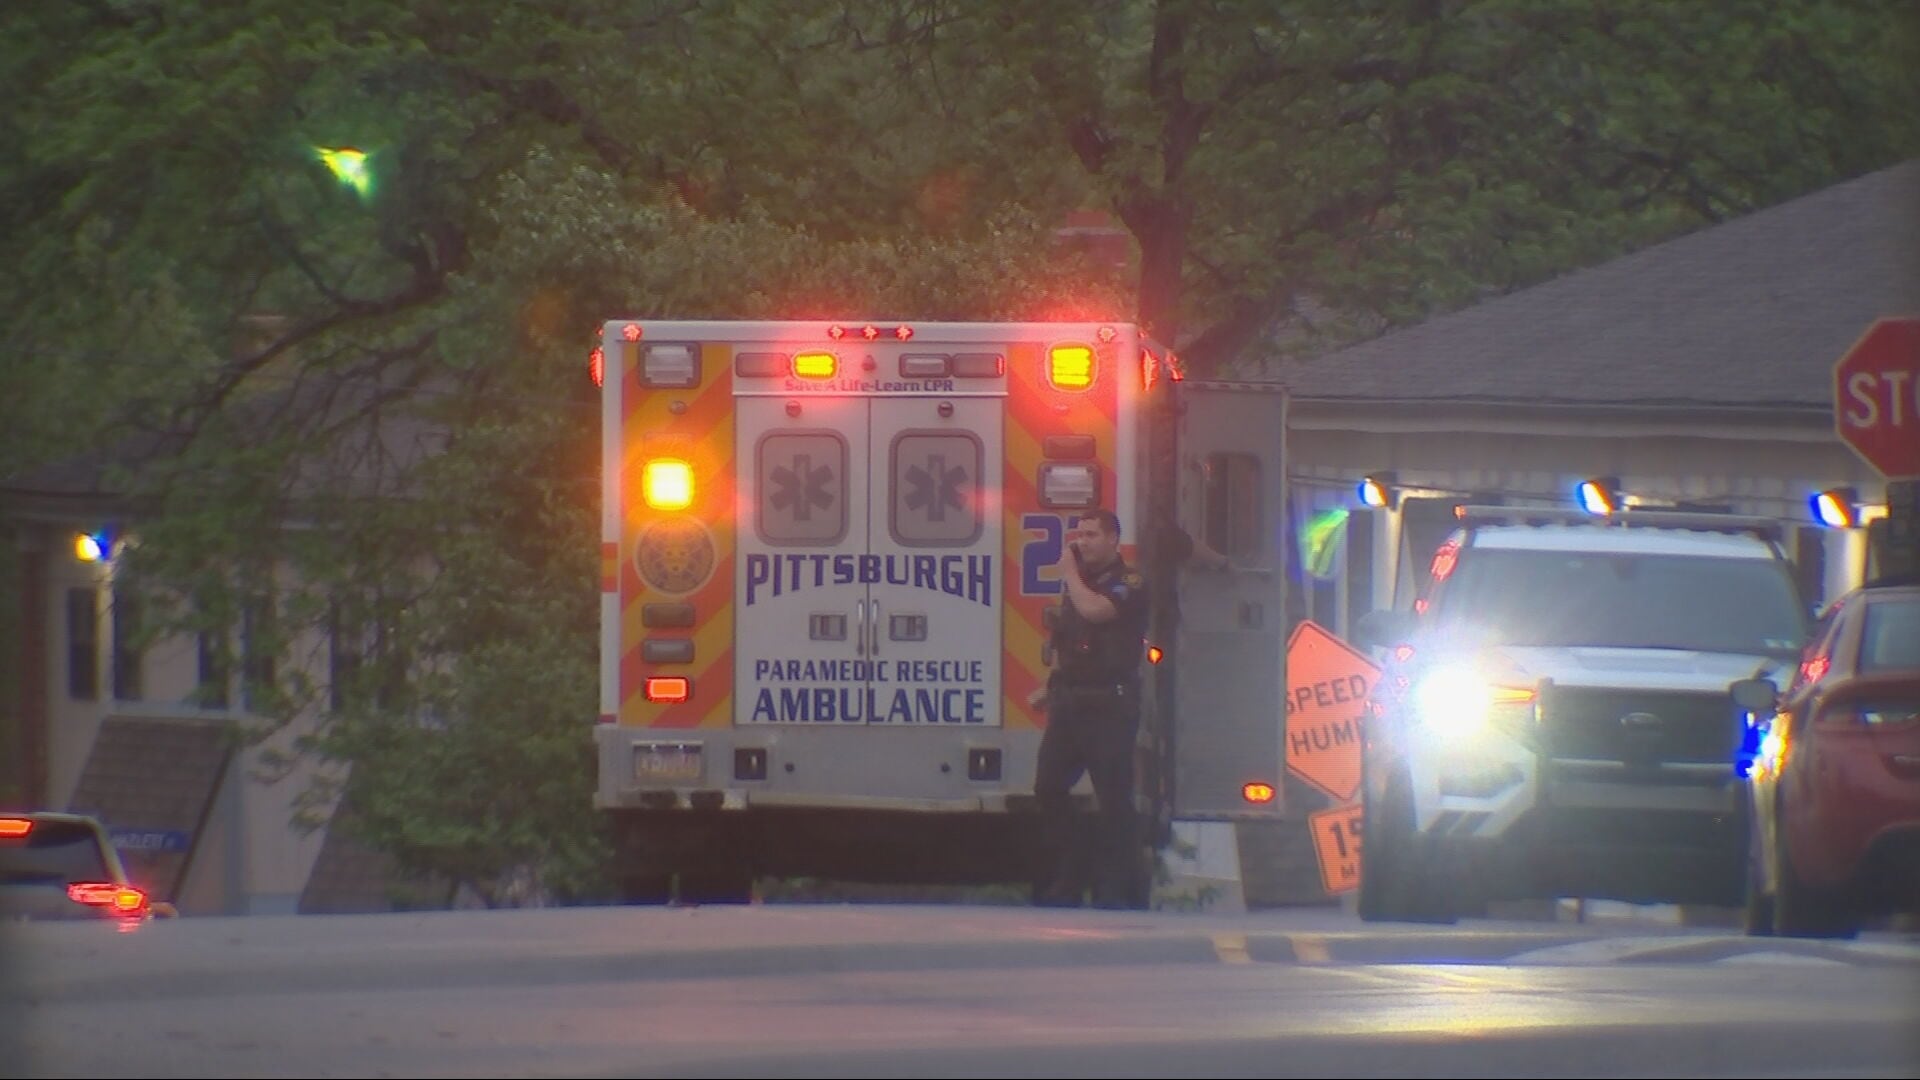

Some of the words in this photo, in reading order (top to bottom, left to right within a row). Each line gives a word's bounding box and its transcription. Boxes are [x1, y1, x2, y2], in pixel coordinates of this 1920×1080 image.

[924, 379, 953, 391] CPR
[1848, 371, 1920, 428] ST
[746, 554, 992, 607] PITTSBURGH
[755, 659, 889, 682] PARAMEDIC
[896, 660, 982, 682] RESCUE
[752, 688, 985, 723] AMBULANCE
